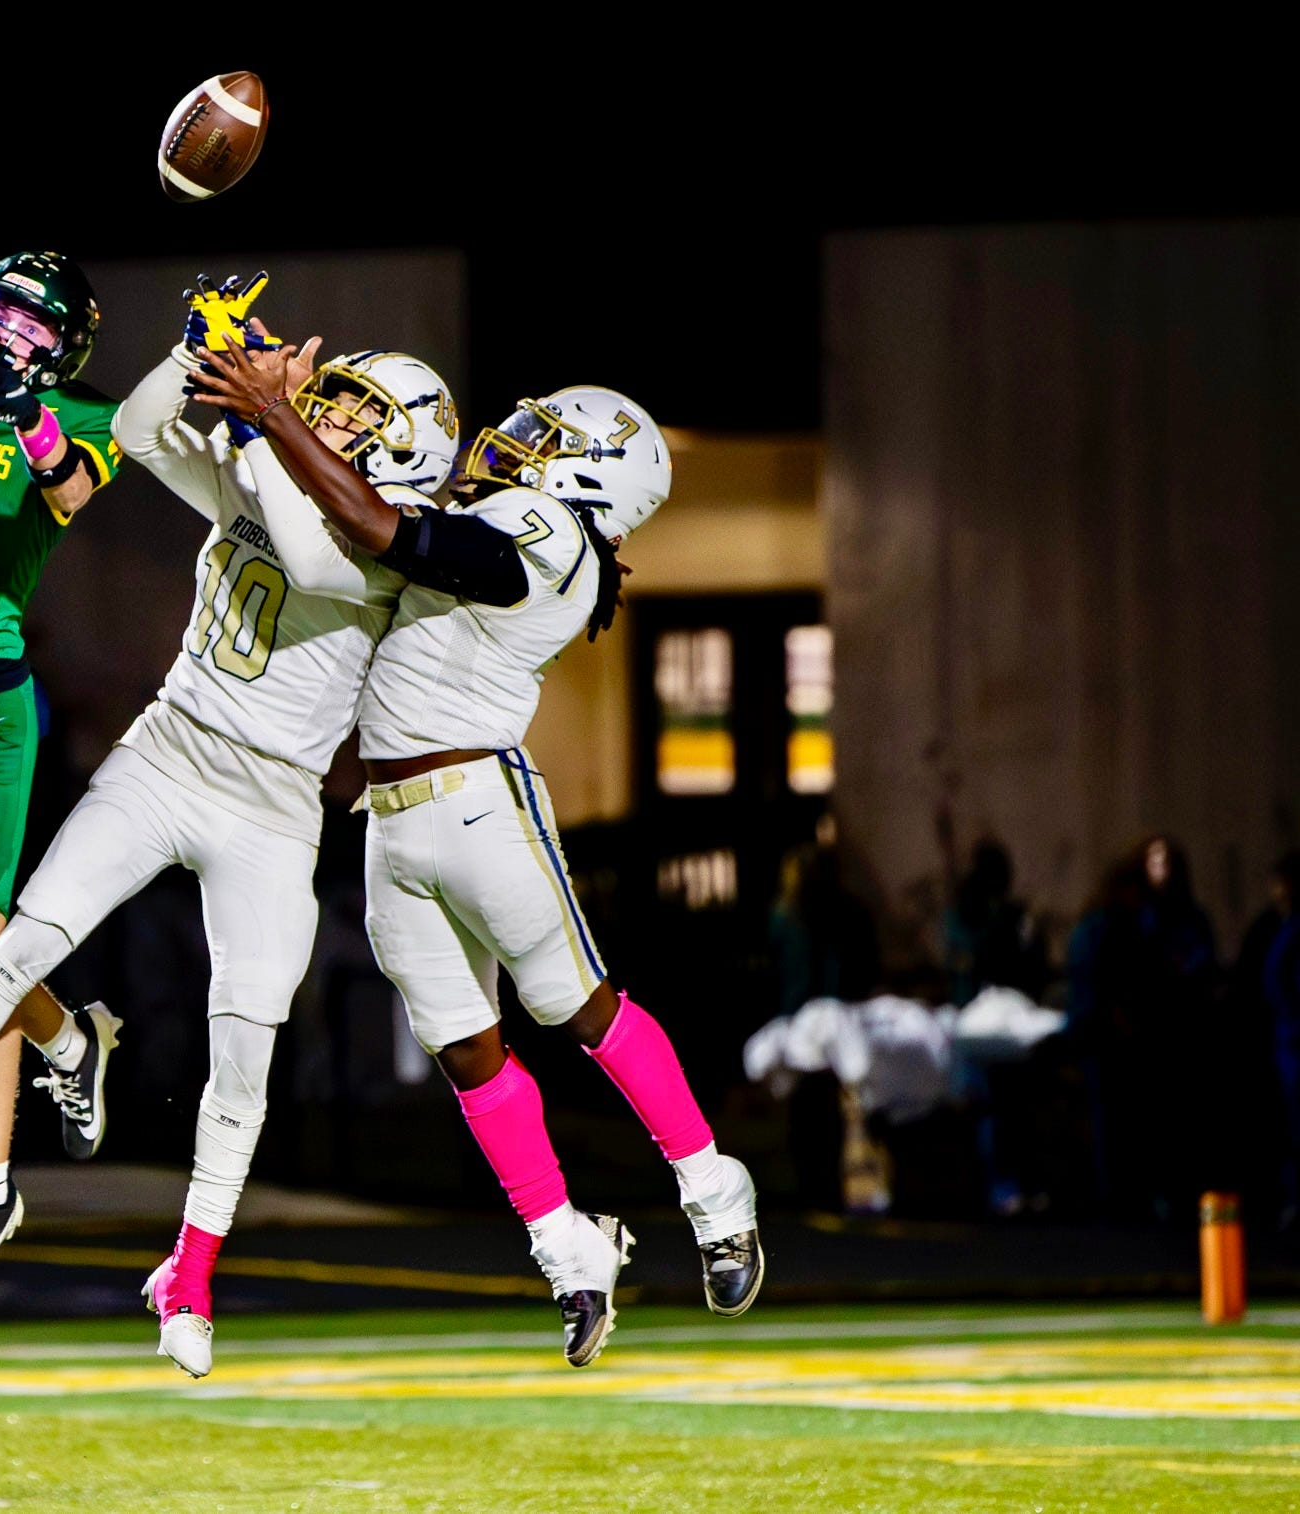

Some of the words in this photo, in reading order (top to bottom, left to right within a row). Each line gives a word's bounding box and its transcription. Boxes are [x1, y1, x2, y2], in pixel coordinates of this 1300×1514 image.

[188, 127, 224, 170] Wilson
[8, 273, 42, 292] Riddell
[433, 388, 458, 441] 10
[606, 409, 642, 449] 7
[228, 513, 280, 562] ROBERS
[513, 508, 555, 548] 7
[188, 537, 290, 684] 10
